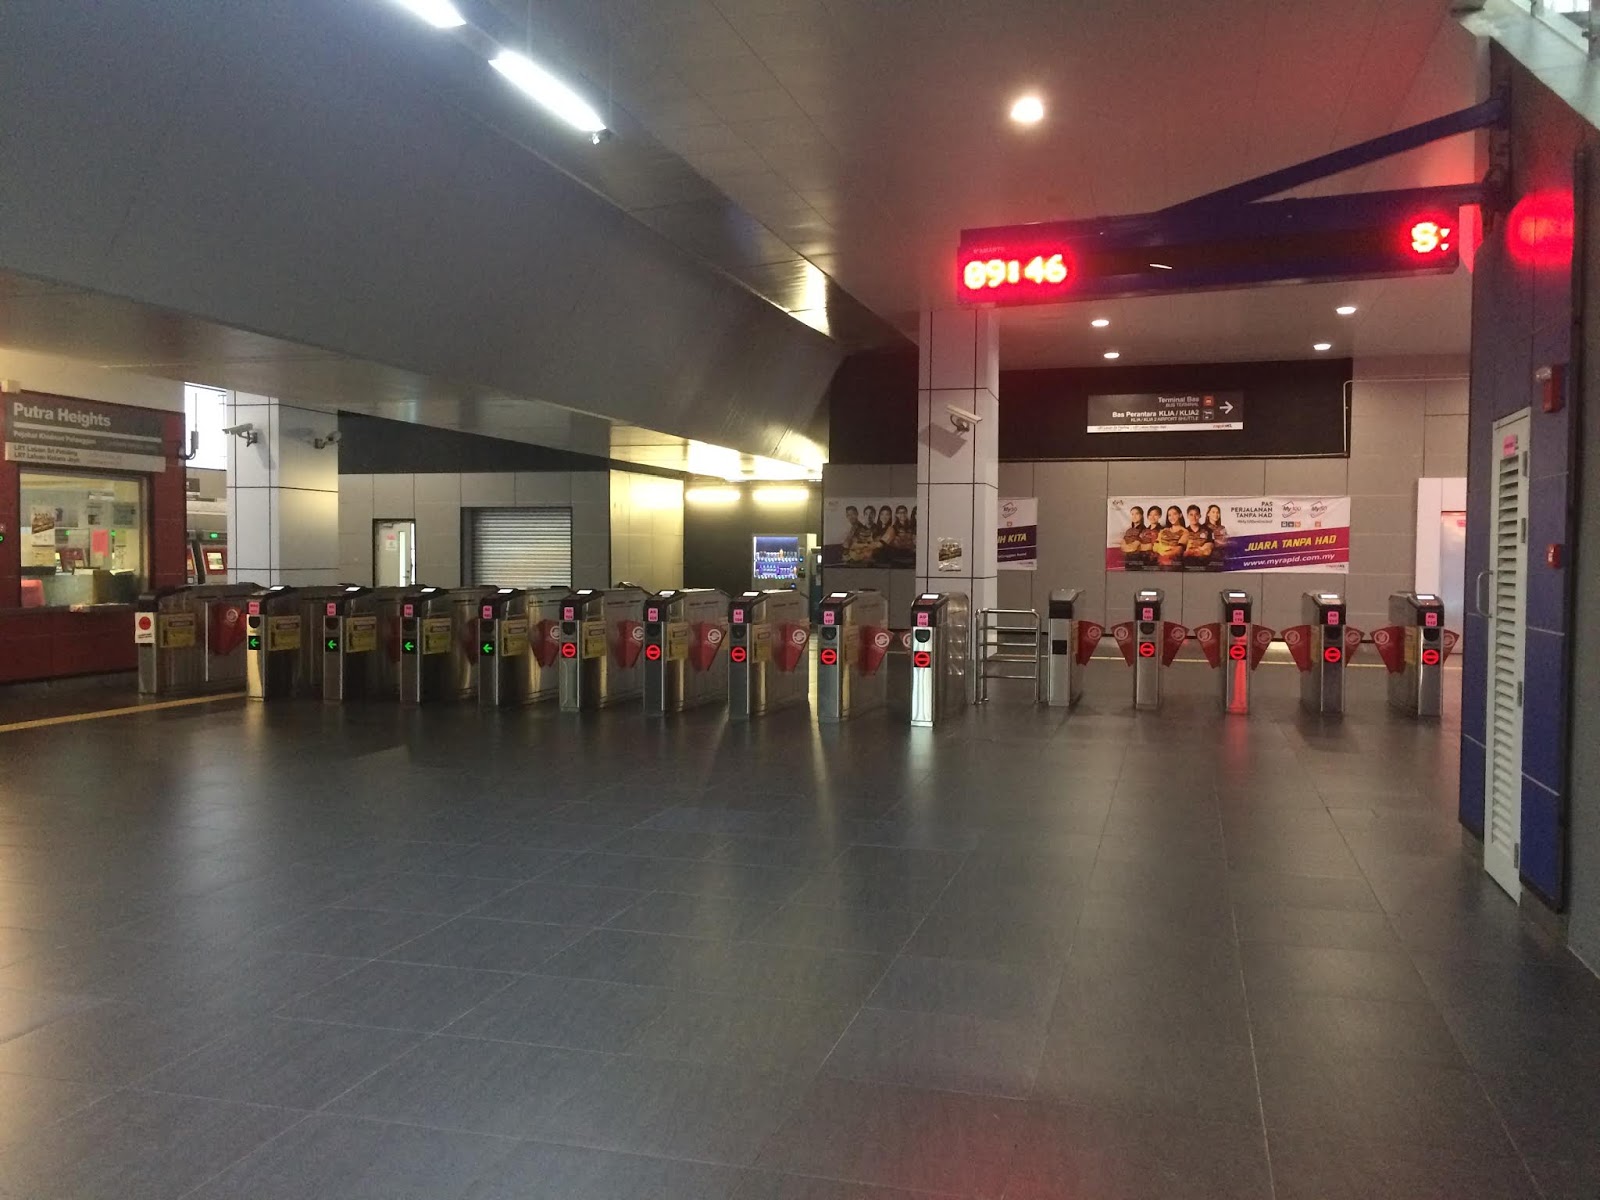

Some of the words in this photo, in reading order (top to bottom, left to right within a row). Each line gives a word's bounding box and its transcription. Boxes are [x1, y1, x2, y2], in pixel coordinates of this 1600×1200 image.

[13, 402, 53, 420] Putra
[58, 407, 111, 427] Heights
[1007, 533, 1027, 543] KITA
[1245, 540, 1278, 552] JUARA
[1282, 538, 1312, 548] TANPA
[1315, 535, 1337, 545] HAD
[1243, 553, 1335, 567] www.myrapid.com.my
